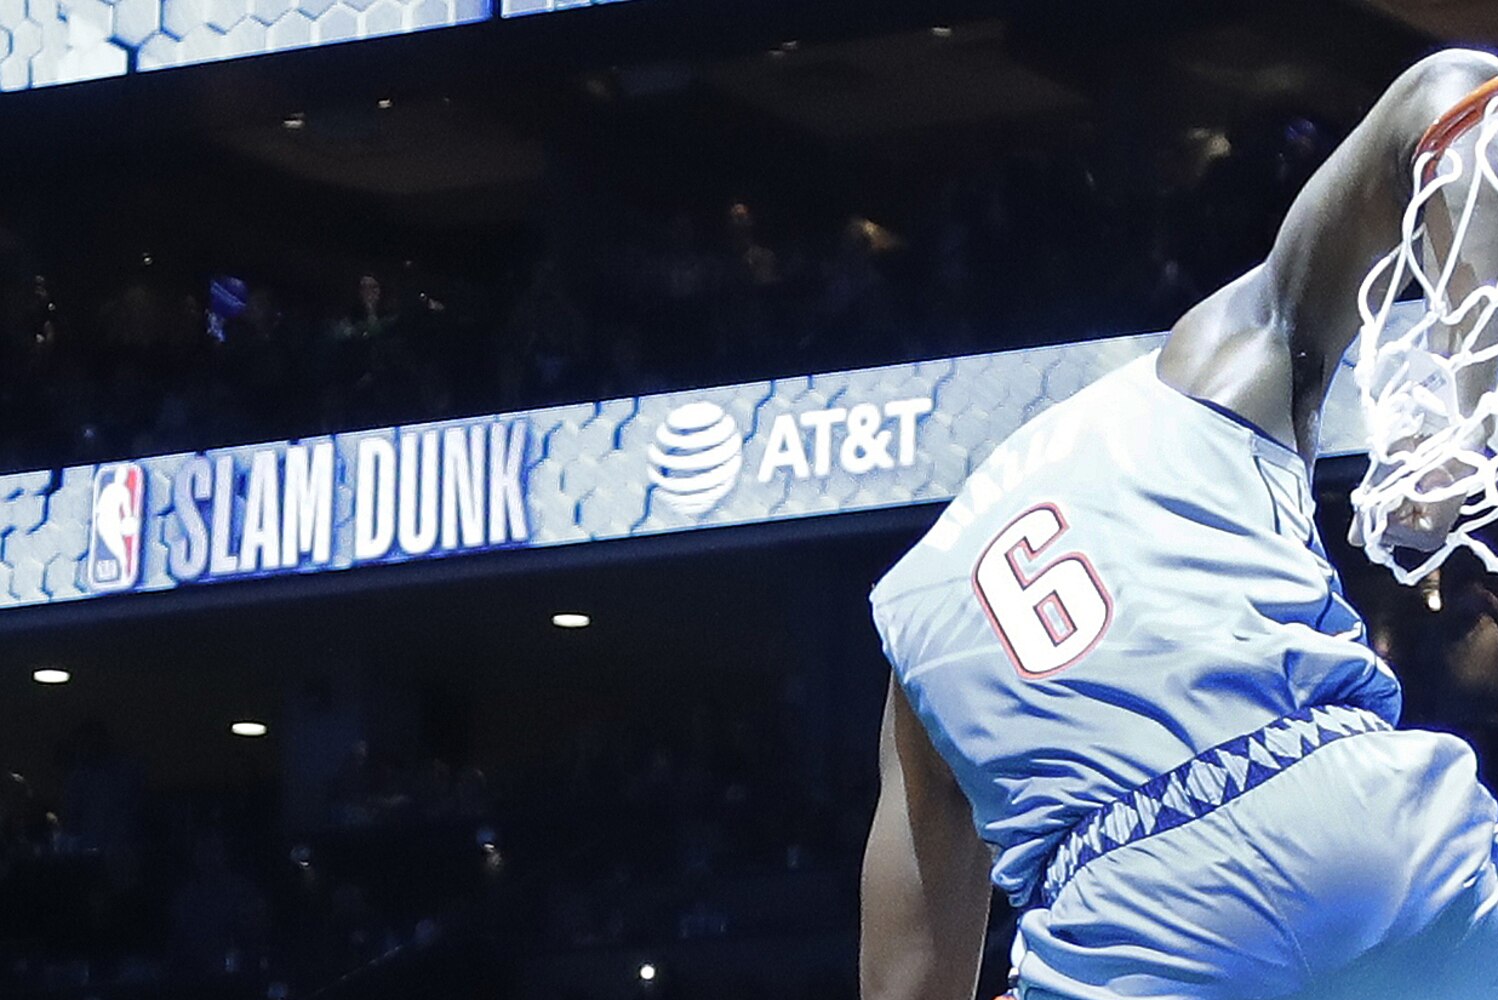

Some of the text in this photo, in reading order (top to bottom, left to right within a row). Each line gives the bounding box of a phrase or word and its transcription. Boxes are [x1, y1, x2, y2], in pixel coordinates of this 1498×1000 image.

[169, 419, 529, 581] SLAM DUNK
[757, 398, 932, 482] AT&T
[971, 501, 1114, 681] 6
